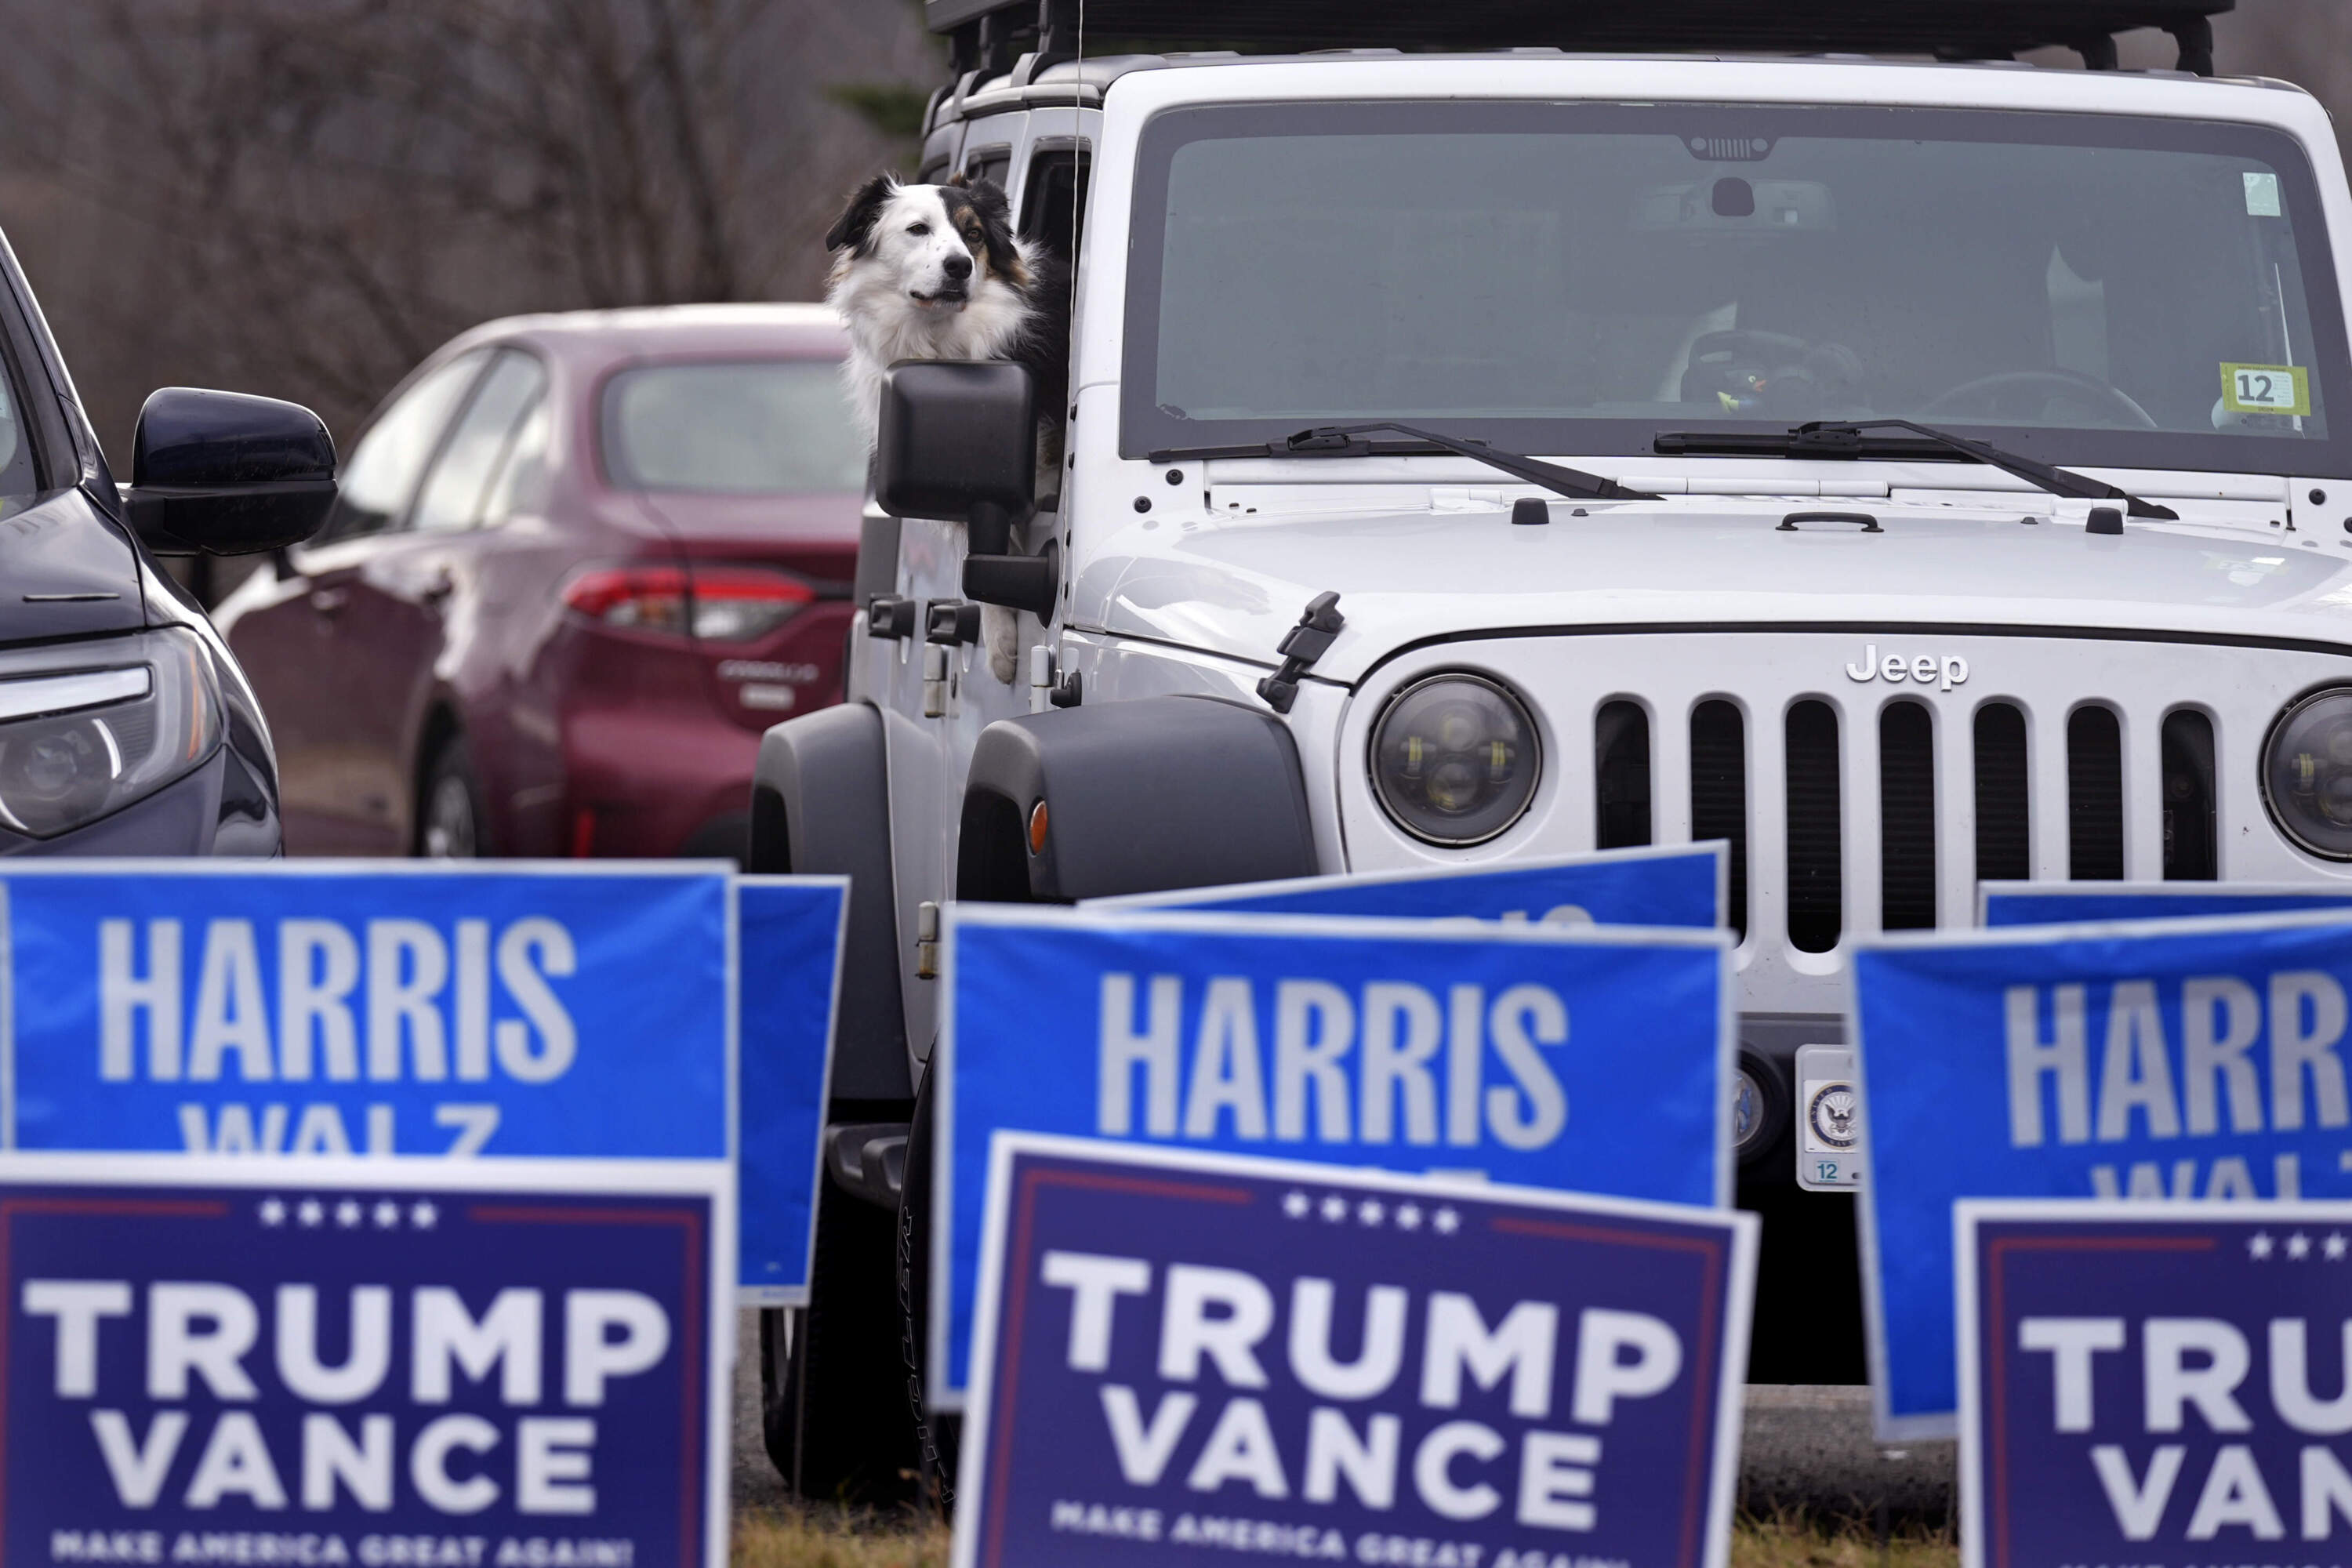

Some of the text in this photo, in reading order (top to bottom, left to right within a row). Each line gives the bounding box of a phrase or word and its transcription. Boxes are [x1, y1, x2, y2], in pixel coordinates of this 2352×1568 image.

[2238, 374, 2275, 402] 12
[1846, 644, 1969, 692] Jeep
[98, 918, 577, 1083] HARRIS
[1098, 974, 1568, 1150] HARRIS
[2005, 971, 2350, 1149] HARR
[1817, 1163, 1838, 1179] 12
[22, 1279, 670, 1406] TRUMP
[1041, 1250, 1682, 1425] TRUMP
[91, 1410, 597, 1515] VANCE
[1101, 1385, 1600, 1532] VANCE
[52, 1531, 634, 1568] MAKE AMERICA GREAT AGAIN!
[1051, 1501, 1162, 1541] MAKE
[1170, 1514, 1346, 1559] AMERICA
[1356, 1533, 1483, 1568] GREAT
